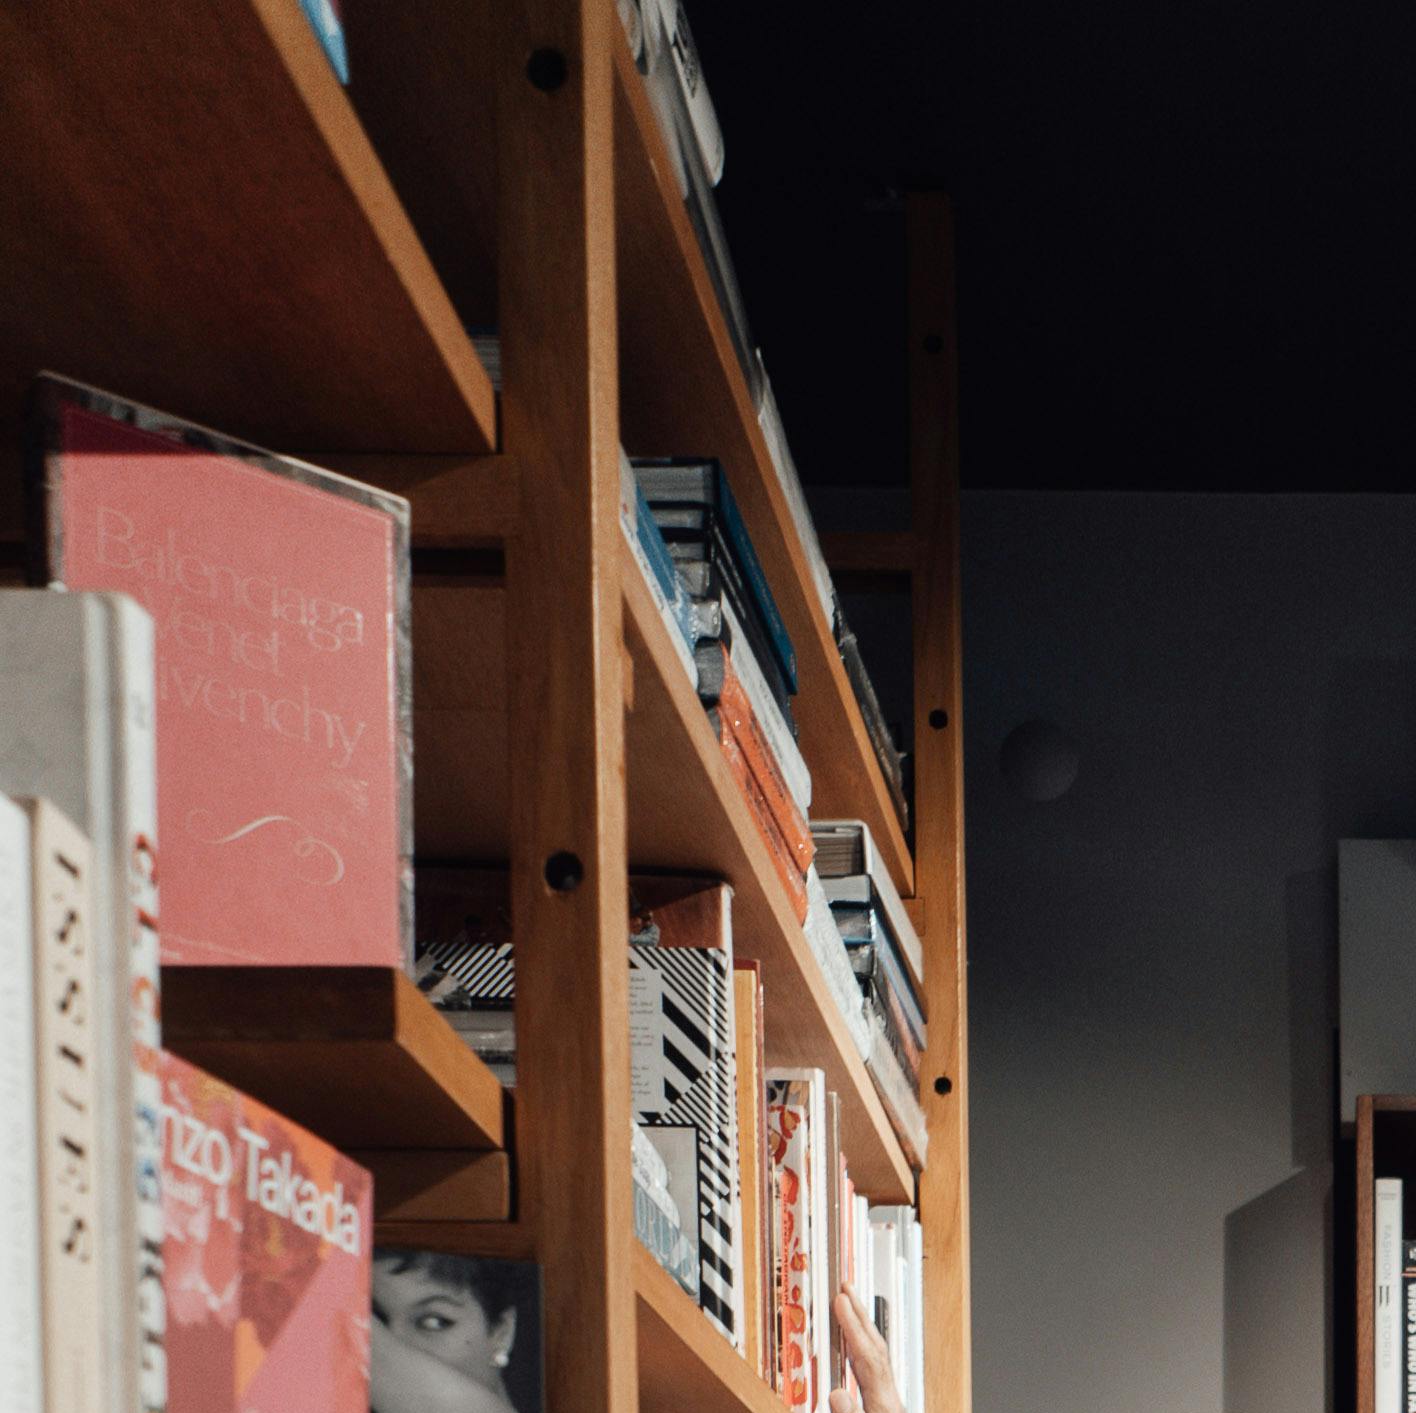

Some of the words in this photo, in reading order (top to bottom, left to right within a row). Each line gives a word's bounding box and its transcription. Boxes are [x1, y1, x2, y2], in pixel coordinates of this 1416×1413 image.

[240, 1127, 360, 1257] Takada
[1383, 1224, 1394, 1280] FASHION
[1382, 1315, 1393, 1368] STORIES
